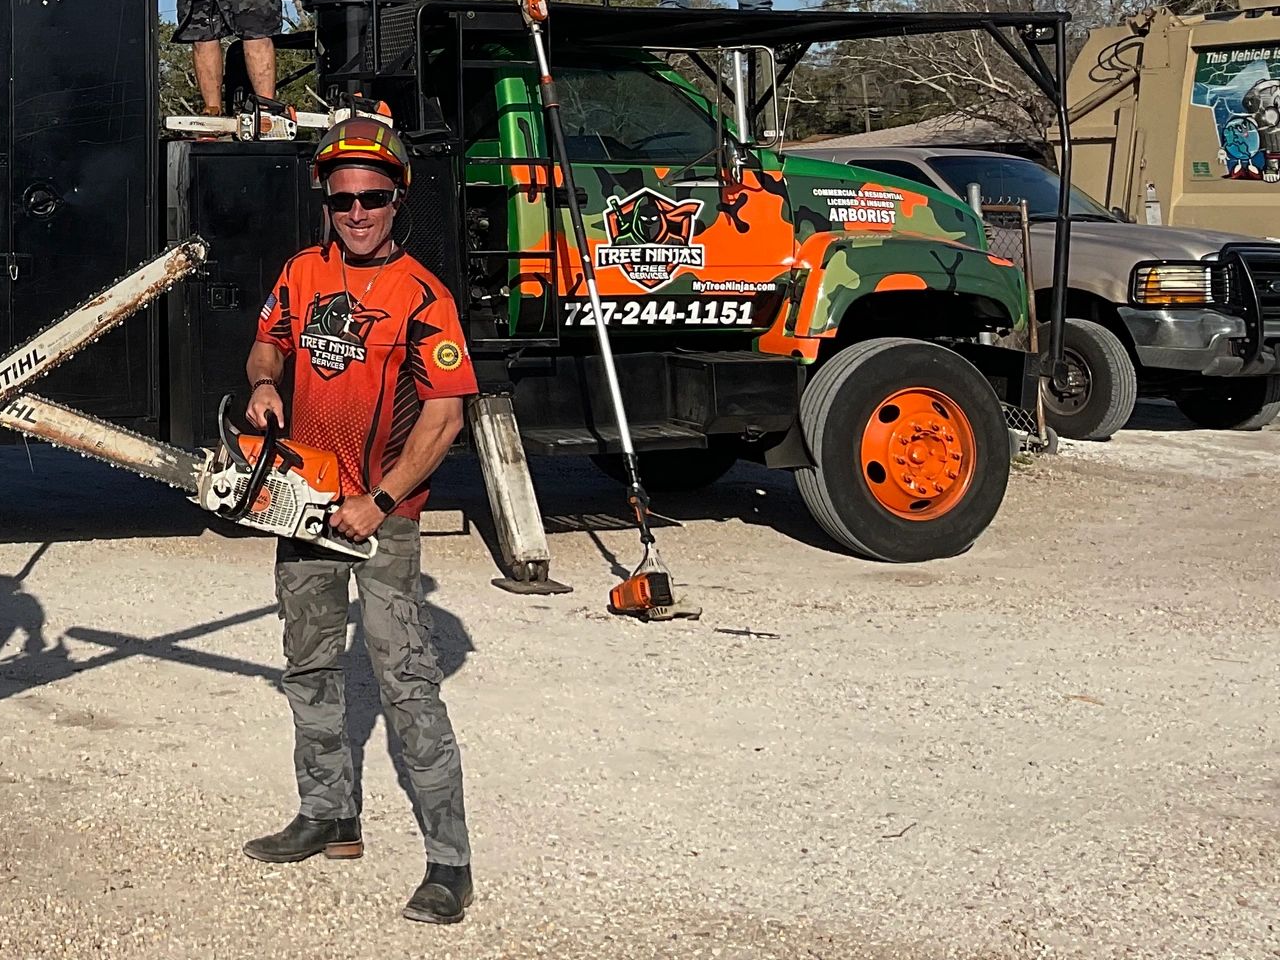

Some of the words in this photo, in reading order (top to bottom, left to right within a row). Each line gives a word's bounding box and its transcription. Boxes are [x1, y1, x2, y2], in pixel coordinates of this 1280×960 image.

[1206, 52, 1229, 64] This
[1231, 48, 1271, 62] Vehicle
[813, 189, 857, 197] COMMERCIAL
[864, 191, 904, 200] RESIDENTIAL
[867, 200, 894, 208] INSURED
[829, 208, 896, 223] ARBORIST
[599, 248, 642, 265] TREE
[646, 248, 702, 265] NINJAS
[692, 281, 776, 292] MyTreeNinjas.com
[565, 301, 753, 325] 727-244-1151
[300, 335, 327, 350] TREE
[314, 350, 343, 362] TREE
